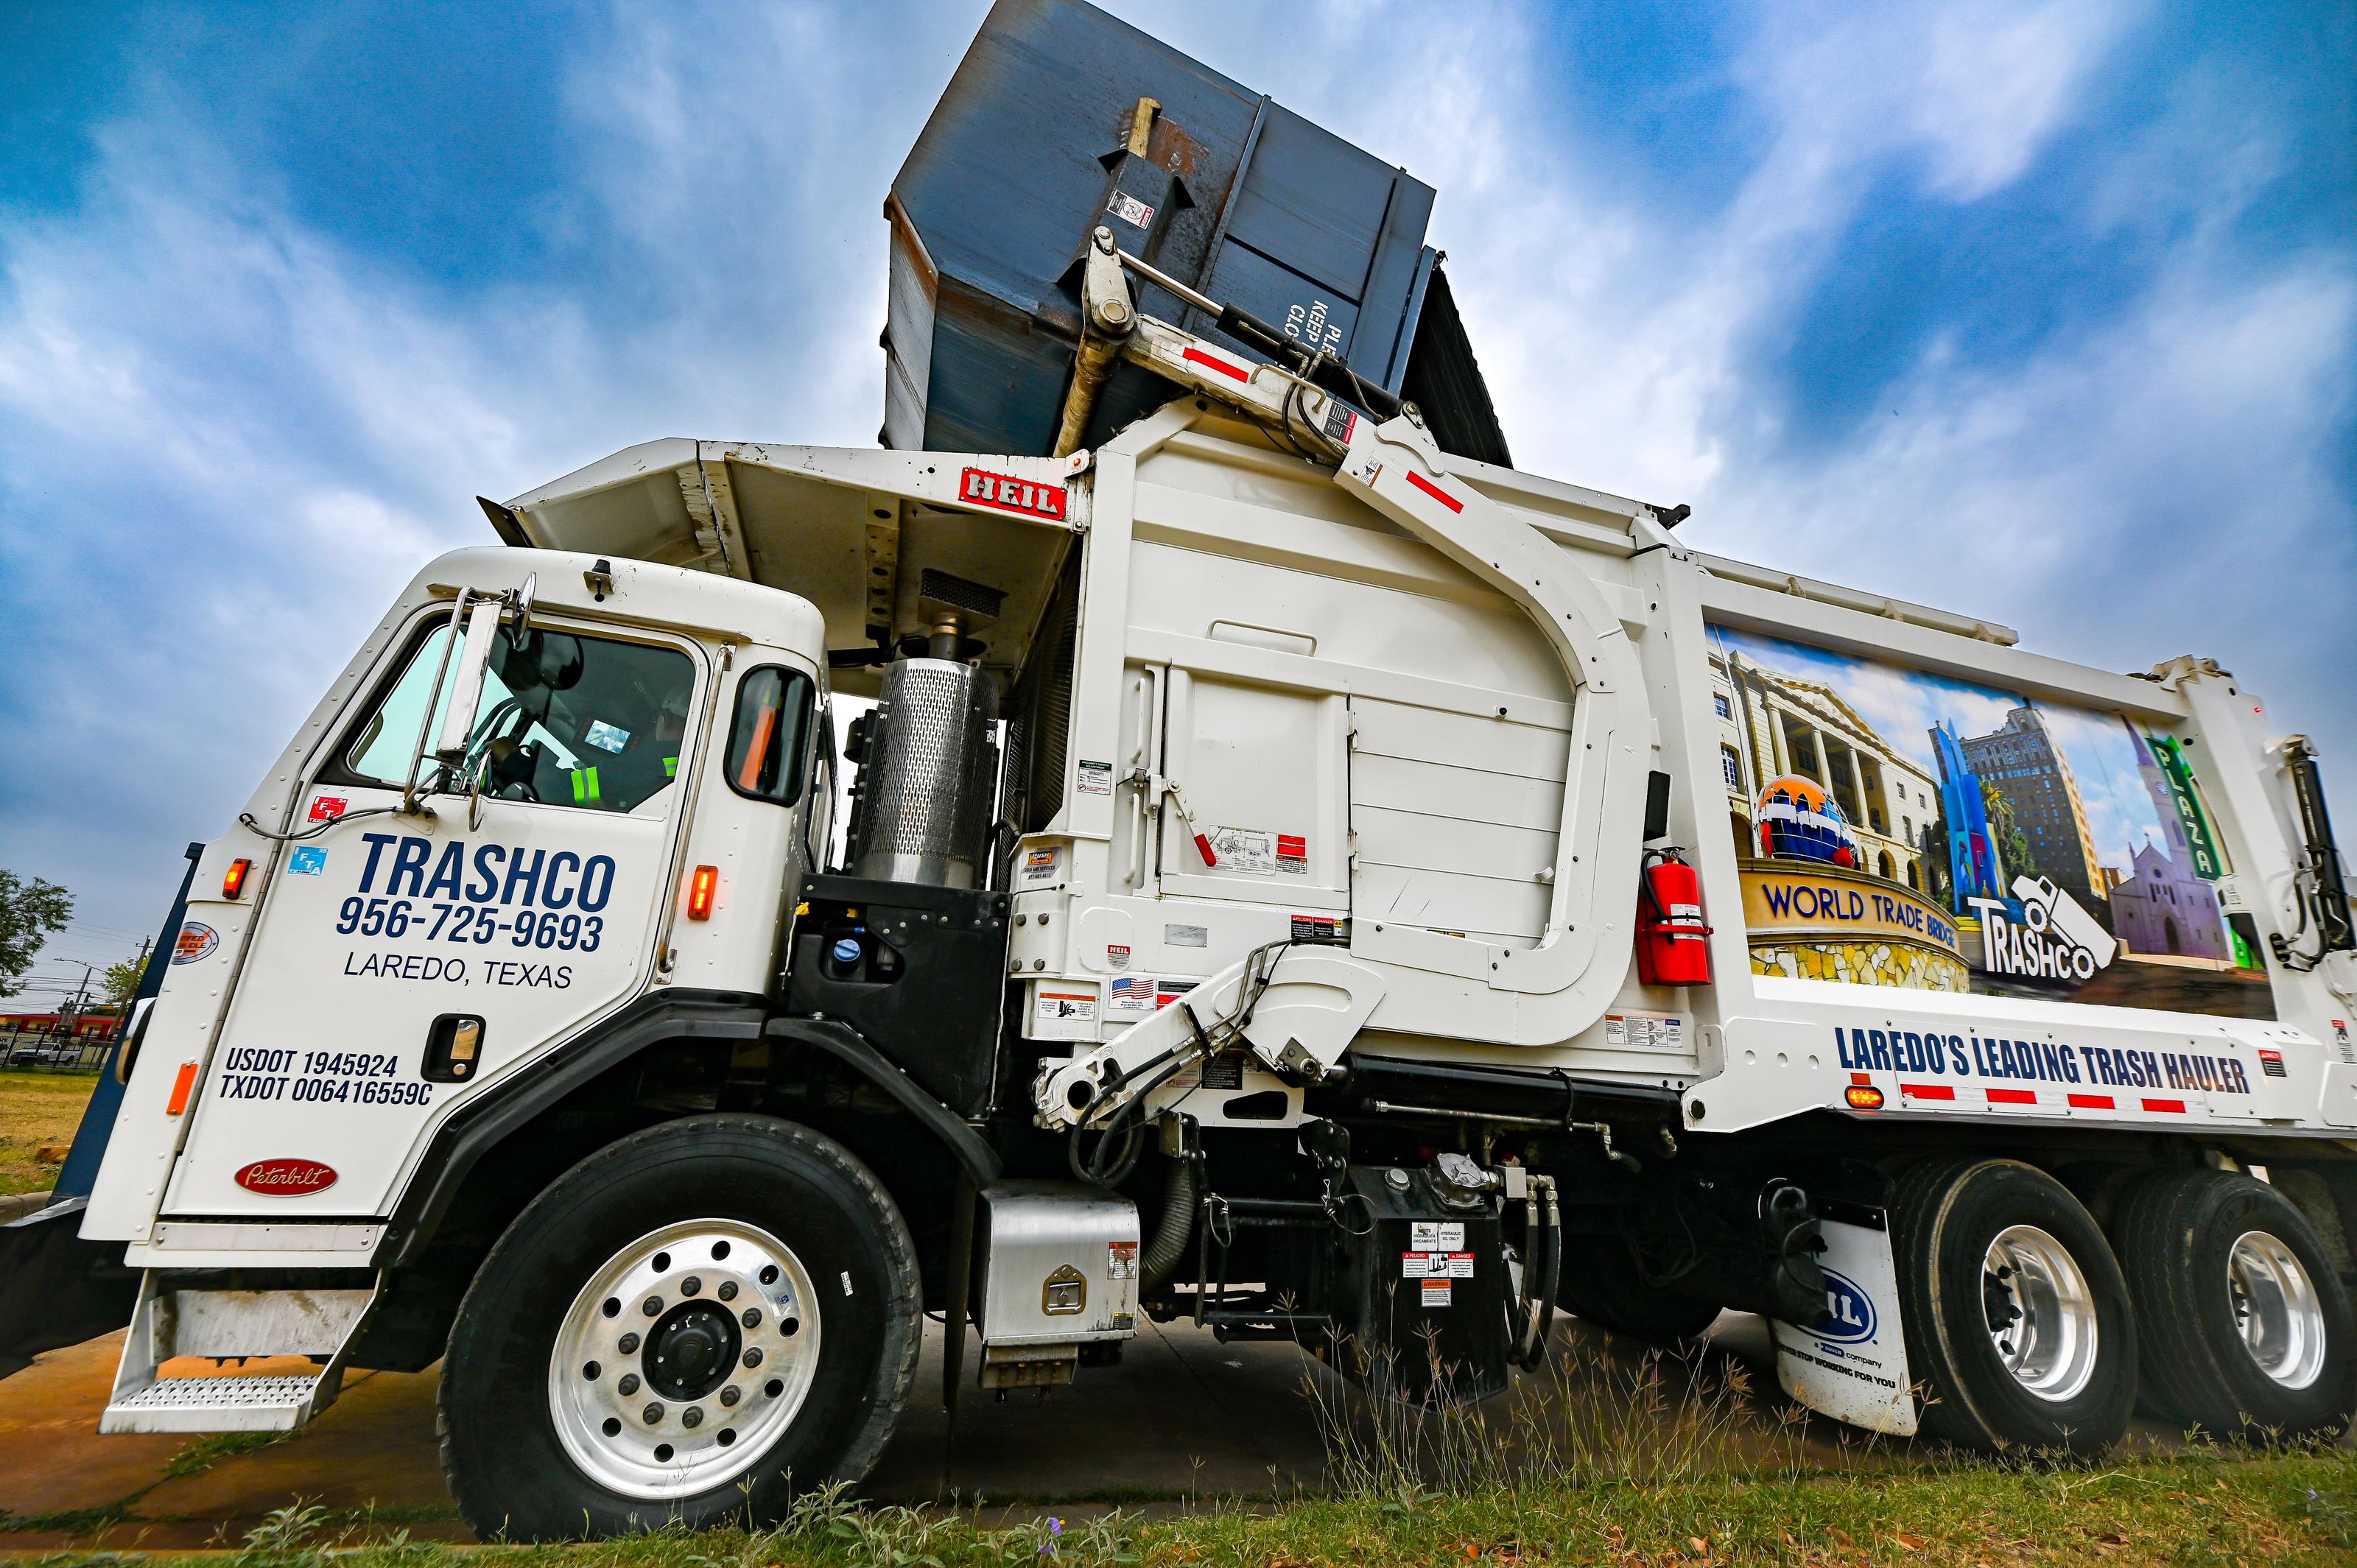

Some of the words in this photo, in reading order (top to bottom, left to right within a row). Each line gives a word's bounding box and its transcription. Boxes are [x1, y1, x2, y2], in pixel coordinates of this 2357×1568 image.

[1284, 304, 1306, 338] CLO
[1305, 300, 1329, 342] KEEP
[1321, 324, 1342, 357] PLE
[967, 473, 1058, 513] HEIL
[2155, 747, 2213, 873] PLAZA
[359, 833, 617, 913] TRASHCO
[336, 896, 603, 952] 956-725-9693
[1762, 883, 1864, 920] WORLD
[1872, 894, 1924, 932] TRADE
[1927, 913, 1956, 948] BRIDGE
[1109, 946, 1129, 954] HEIL
[344, 952, 471, 988] LAREDO,
[482, 961, 572, 989] TEXAS
[225, 1047, 295, 1073] USDOT
[302, 1051, 398, 1077] 1945924
[1835, 1027, 1970, 1076] LAREDO'S
[1970, 1037, 2082, 1083] LEADING
[2079, 1047, 2163, 1089] TRASH
[2161, 1053, 2251, 1094] HAULER
[219, 1075, 286, 1100] TXDOT
[292, 1079, 434, 1105] 006416559C
[245, 1162, 327, 1186] Peterbilt
[1796, 1349, 1814, 1363] STOP
[1814, 1357, 1854, 1377] WORKING
[1854, 1370, 1873, 1383] FOR
[1874, 1375, 1897, 1389] YOU
[1846, 1352, 1883, 1368] company
